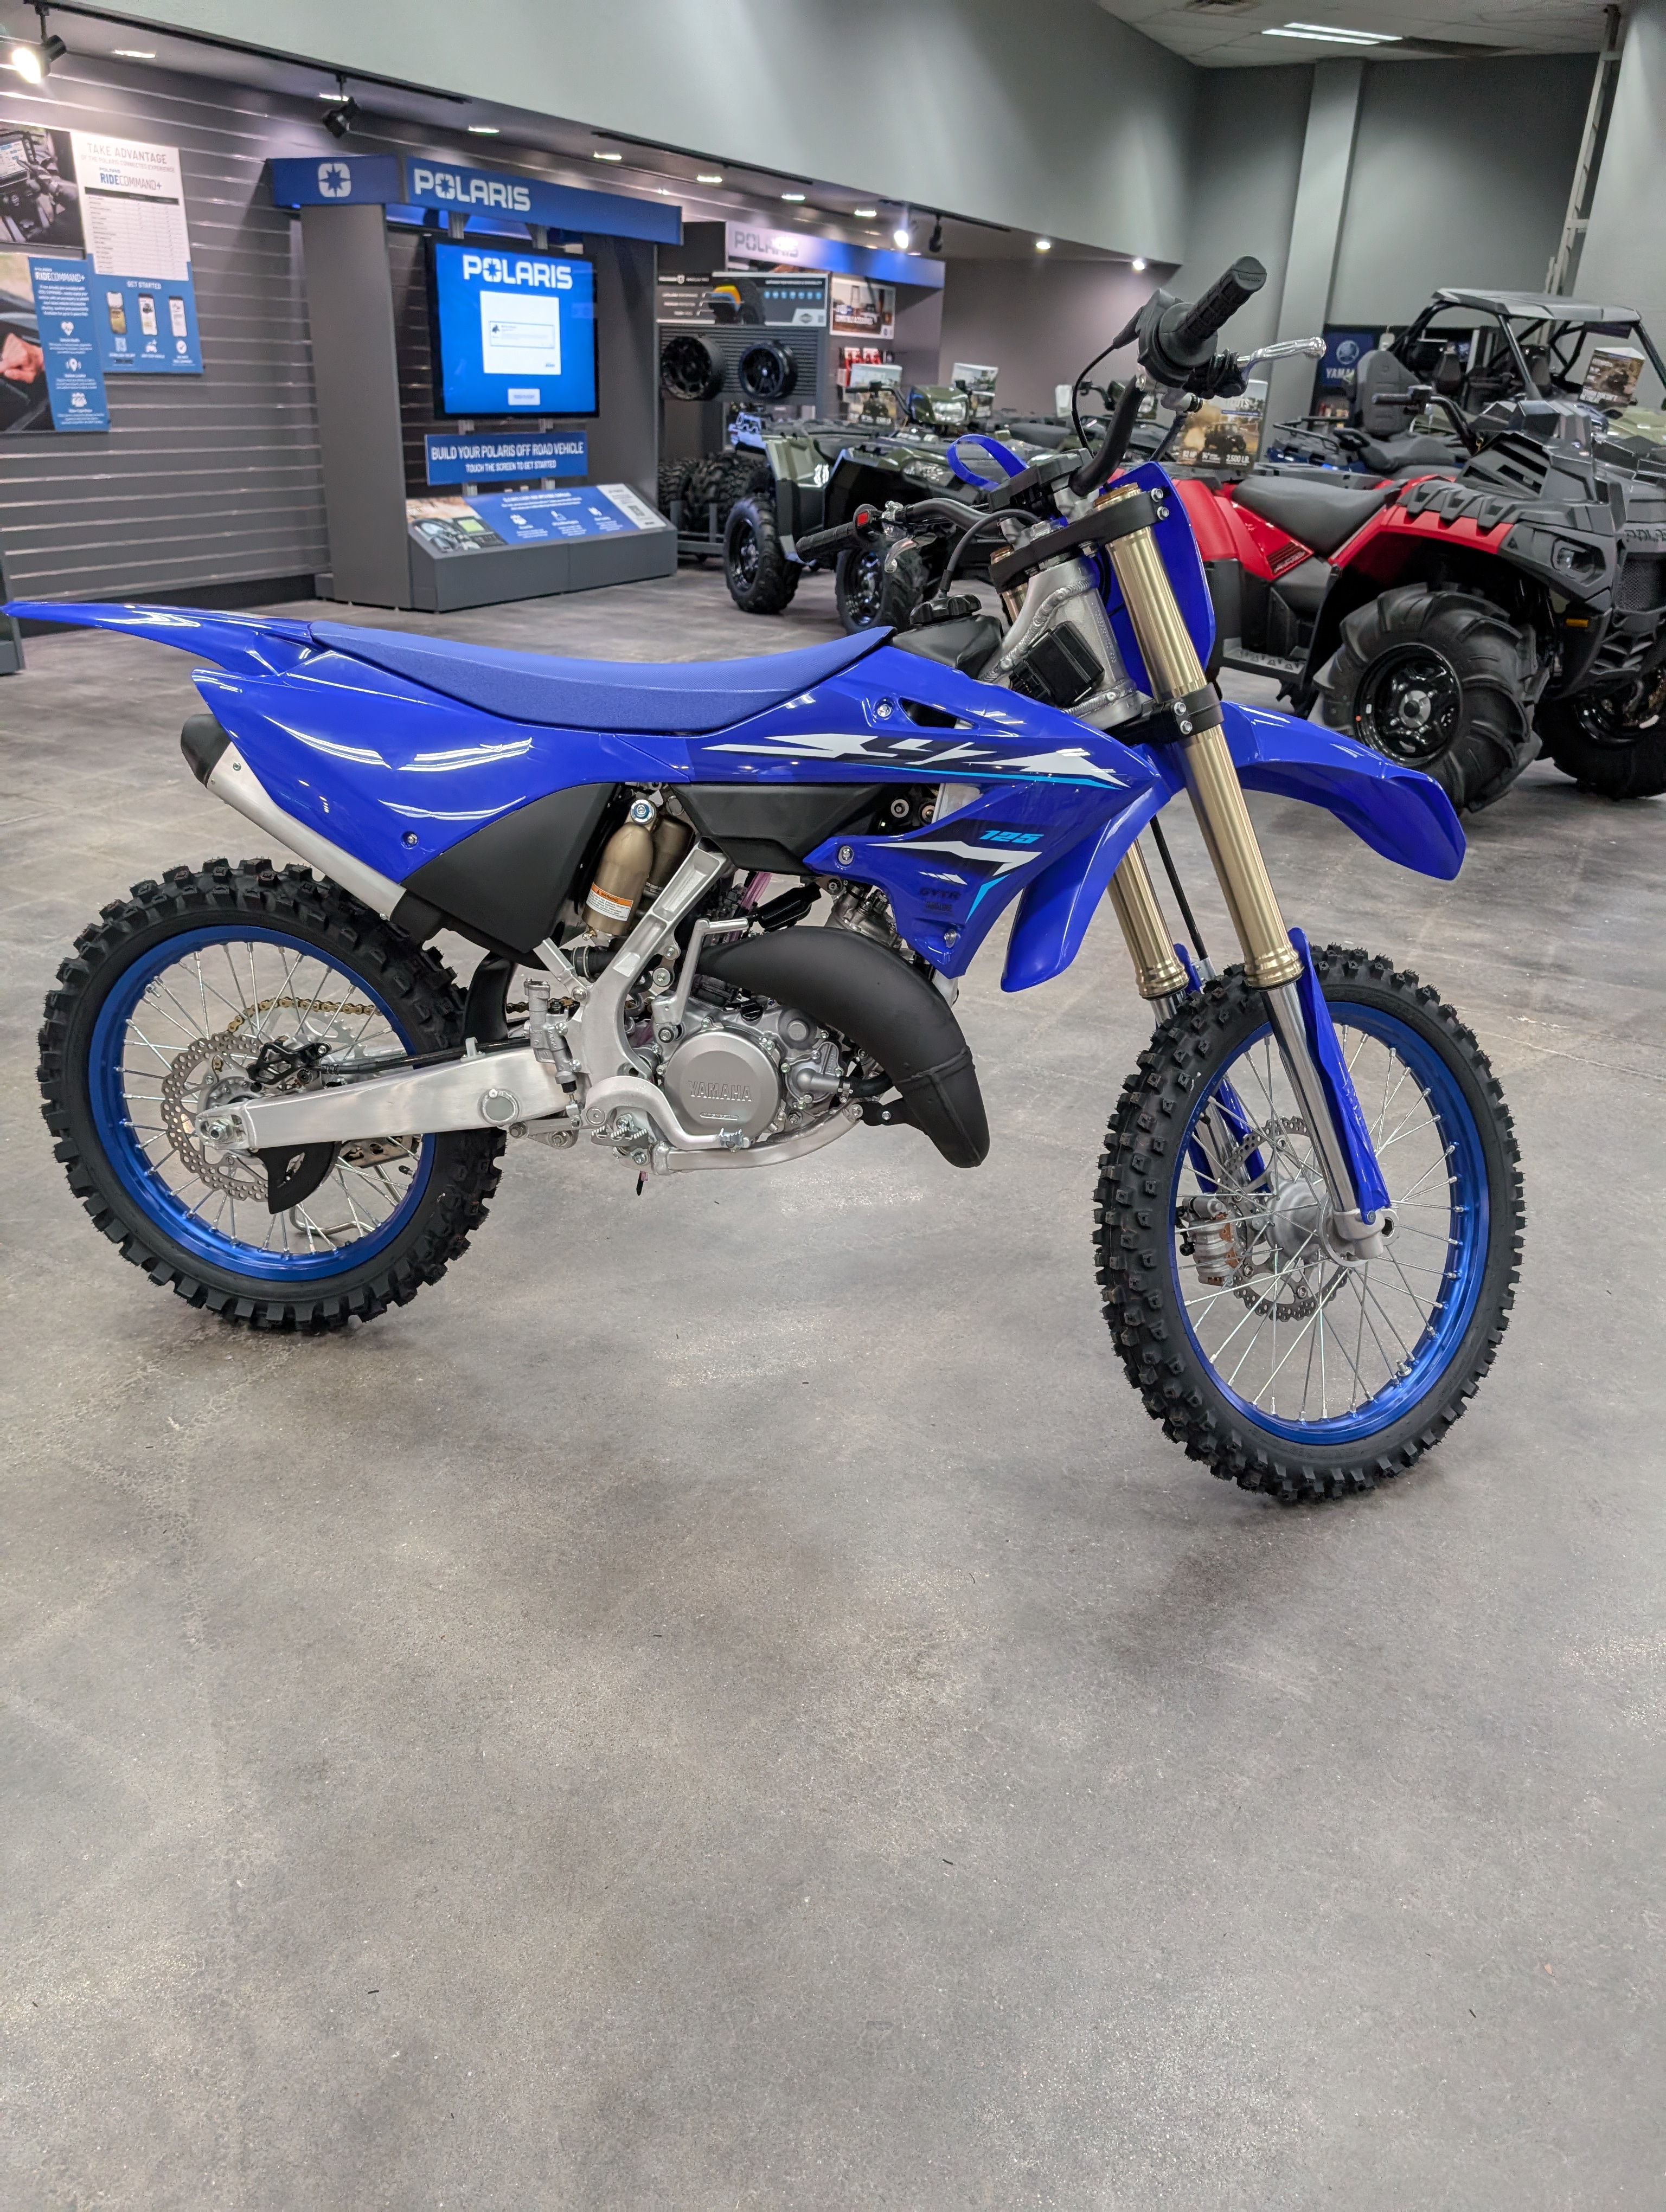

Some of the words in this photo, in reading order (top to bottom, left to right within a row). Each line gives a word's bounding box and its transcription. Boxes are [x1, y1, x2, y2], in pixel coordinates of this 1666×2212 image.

[87, 143, 112, 156] TAKE
[115, 147, 167, 164] ADVANTAGE
[414, 168, 531, 211] POLARIS
[734, 230, 799, 258] POLA
[463, 254, 573, 290] POLARIS
[138, 281, 162, 290] STARTED
[1326, 367, 1355, 380] YAMA
[431, 445, 457, 460] BUILD
[459, 445, 480, 459] YOUR
[482, 444, 515, 458] POLARIS
[516, 443, 531, 457] OFF
[533, 443, 553, 456] ROAD
[554, 442, 584, 455] VEHICLE
[465, 464, 484, 473] TOUCH
[485, 462, 495, 472] THE
[496, 462, 516, 472] SCREEN
[517, 461, 524, 471] TO
[524, 461, 533, 470] GET
[534, 460, 557, 470] STARTED
[979, 830, 1045, 844] 125
[601, 892, 619, 902] WARNING
[919, 887, 960, 900] GYTR
[688, 1080, 752, 1102] YAMAHA
